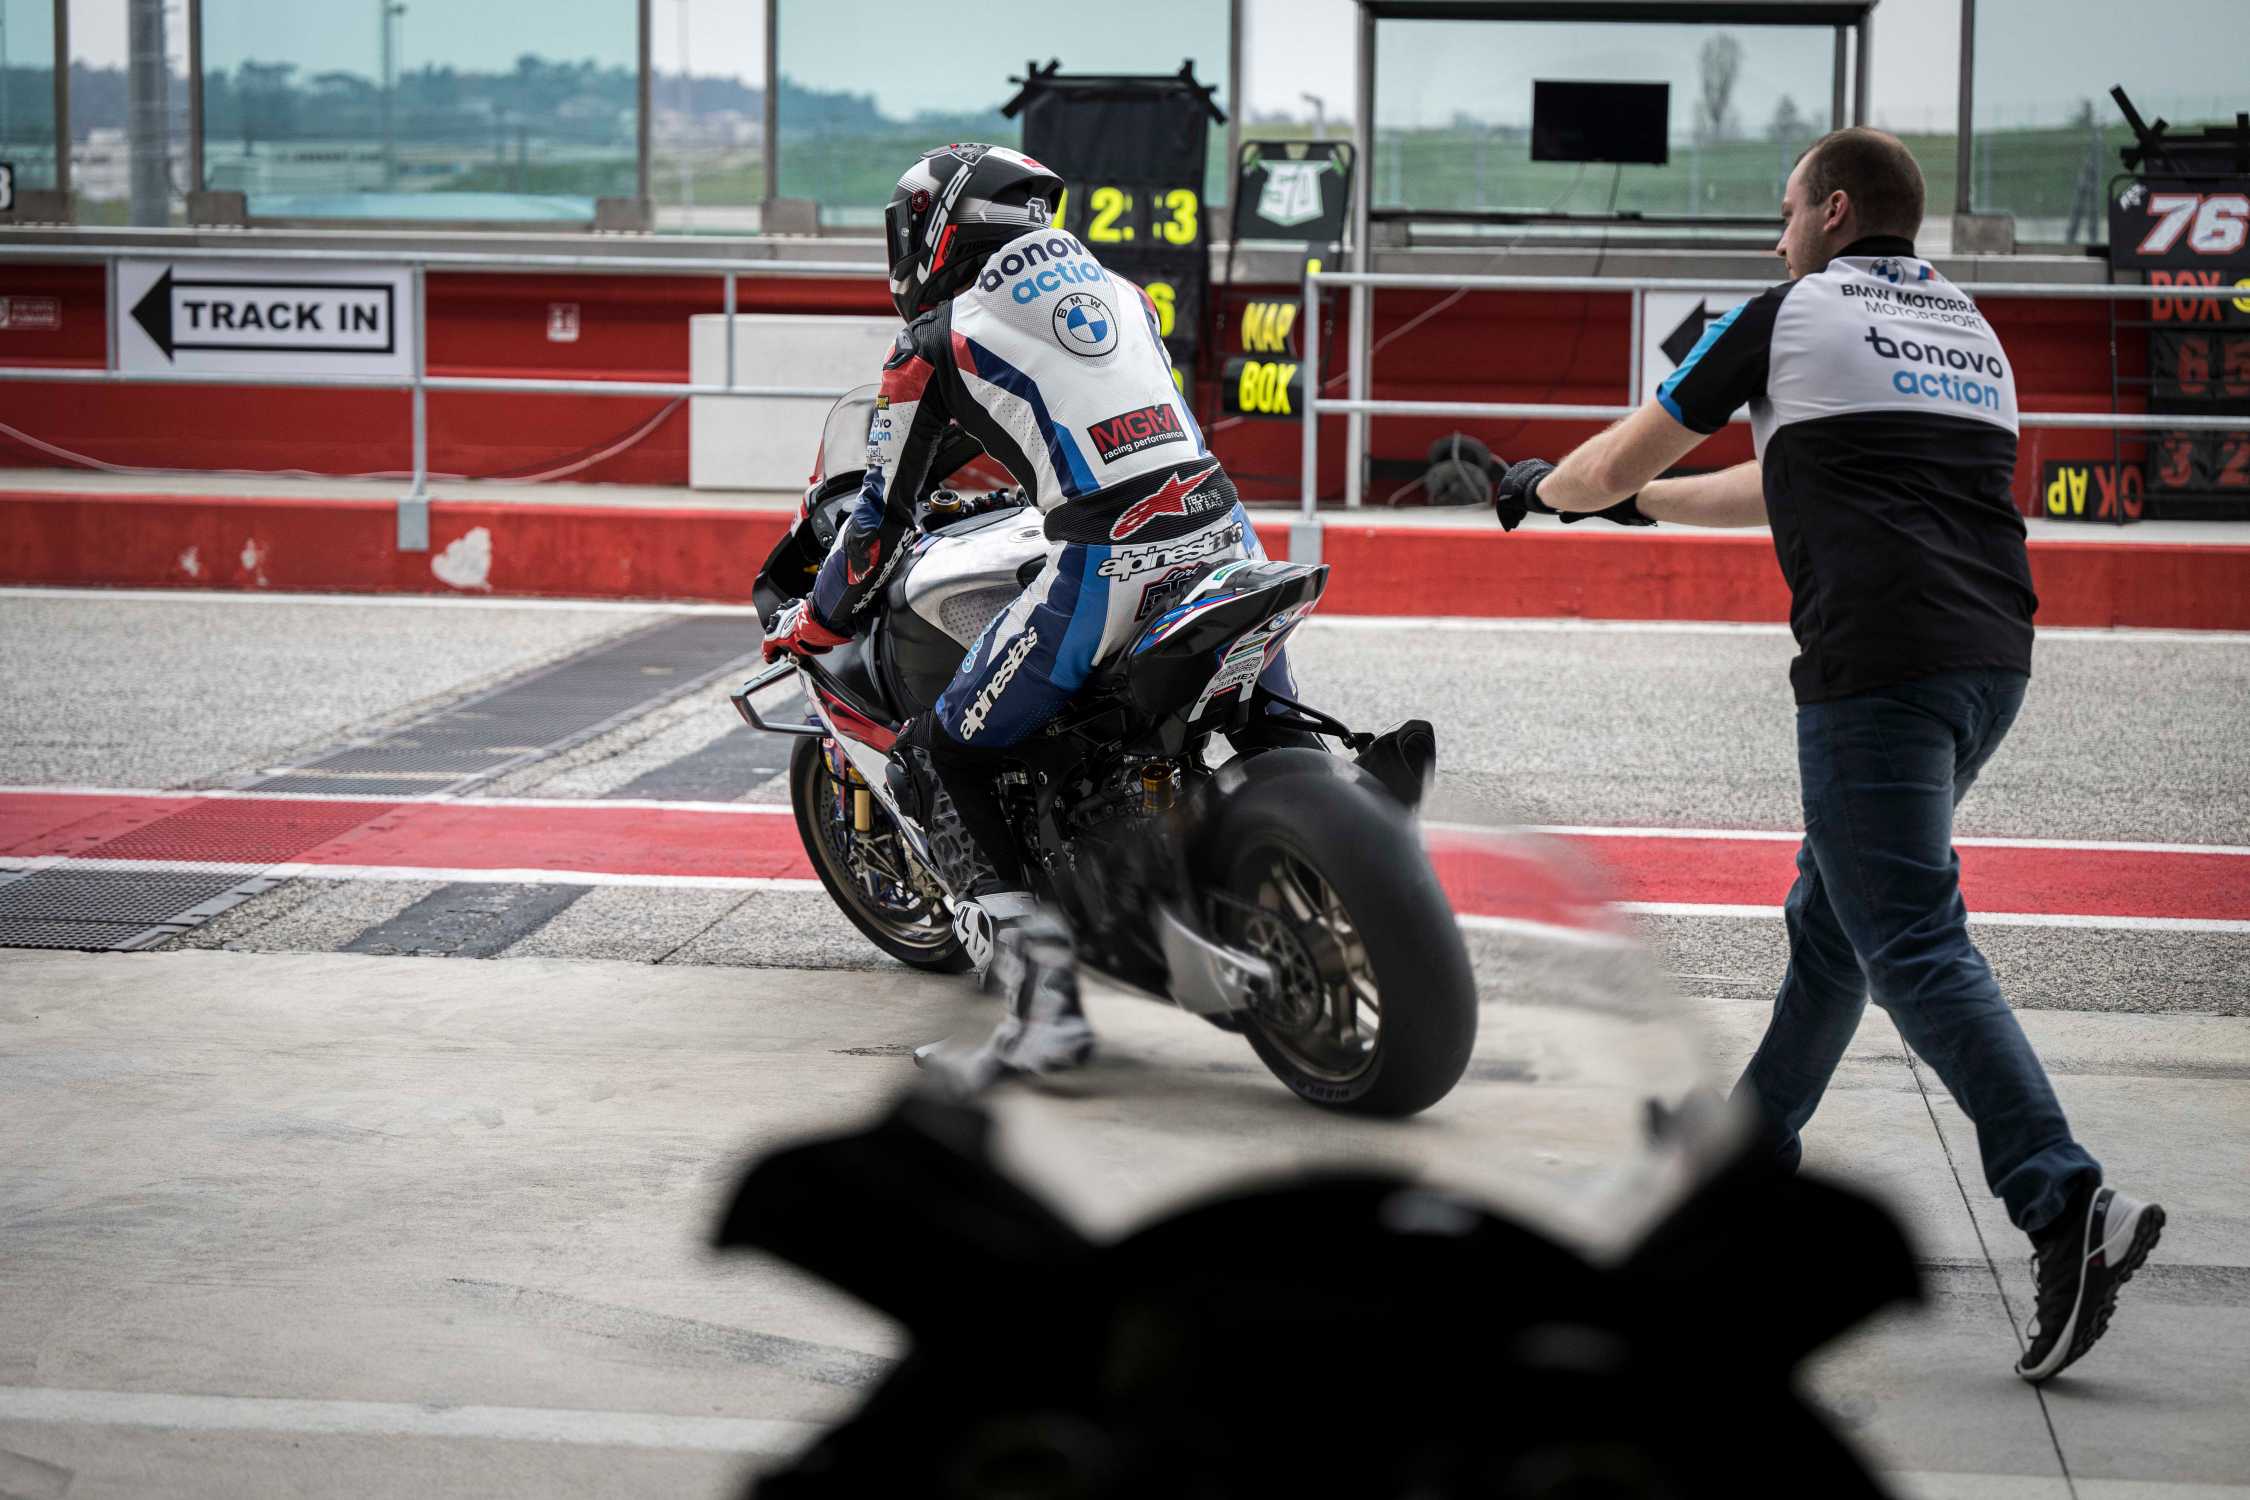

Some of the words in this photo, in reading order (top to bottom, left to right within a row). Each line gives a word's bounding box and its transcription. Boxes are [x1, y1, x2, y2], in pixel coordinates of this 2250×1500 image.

[2136, 193, 2250, 255] 76
[978, 237, 1084, 293] bonov
[182, 301, 323, 330] TRACK
[339, 304, 378, 331] IN
[1056, 296, 1101, 319] BMW
[1841, 284, 1889, 301] BMW
[1896, 291, 1977, 313] MOTORRA
[2151, 270, 2222, 321] BOX
[1864, 326, 2004, 379] bonovo
[1239, 361, 1297, 415] BOX
[1892, 369, 1999, 410] action
[1091, 403, 1182, 452] MGM
[1104, 443, 1133, 460] racing
[1133, 430, 1185, 449] performance
[1097, 521, 1244, 582] alpinestars
[960, 626, 1038, 740] alpinestars
